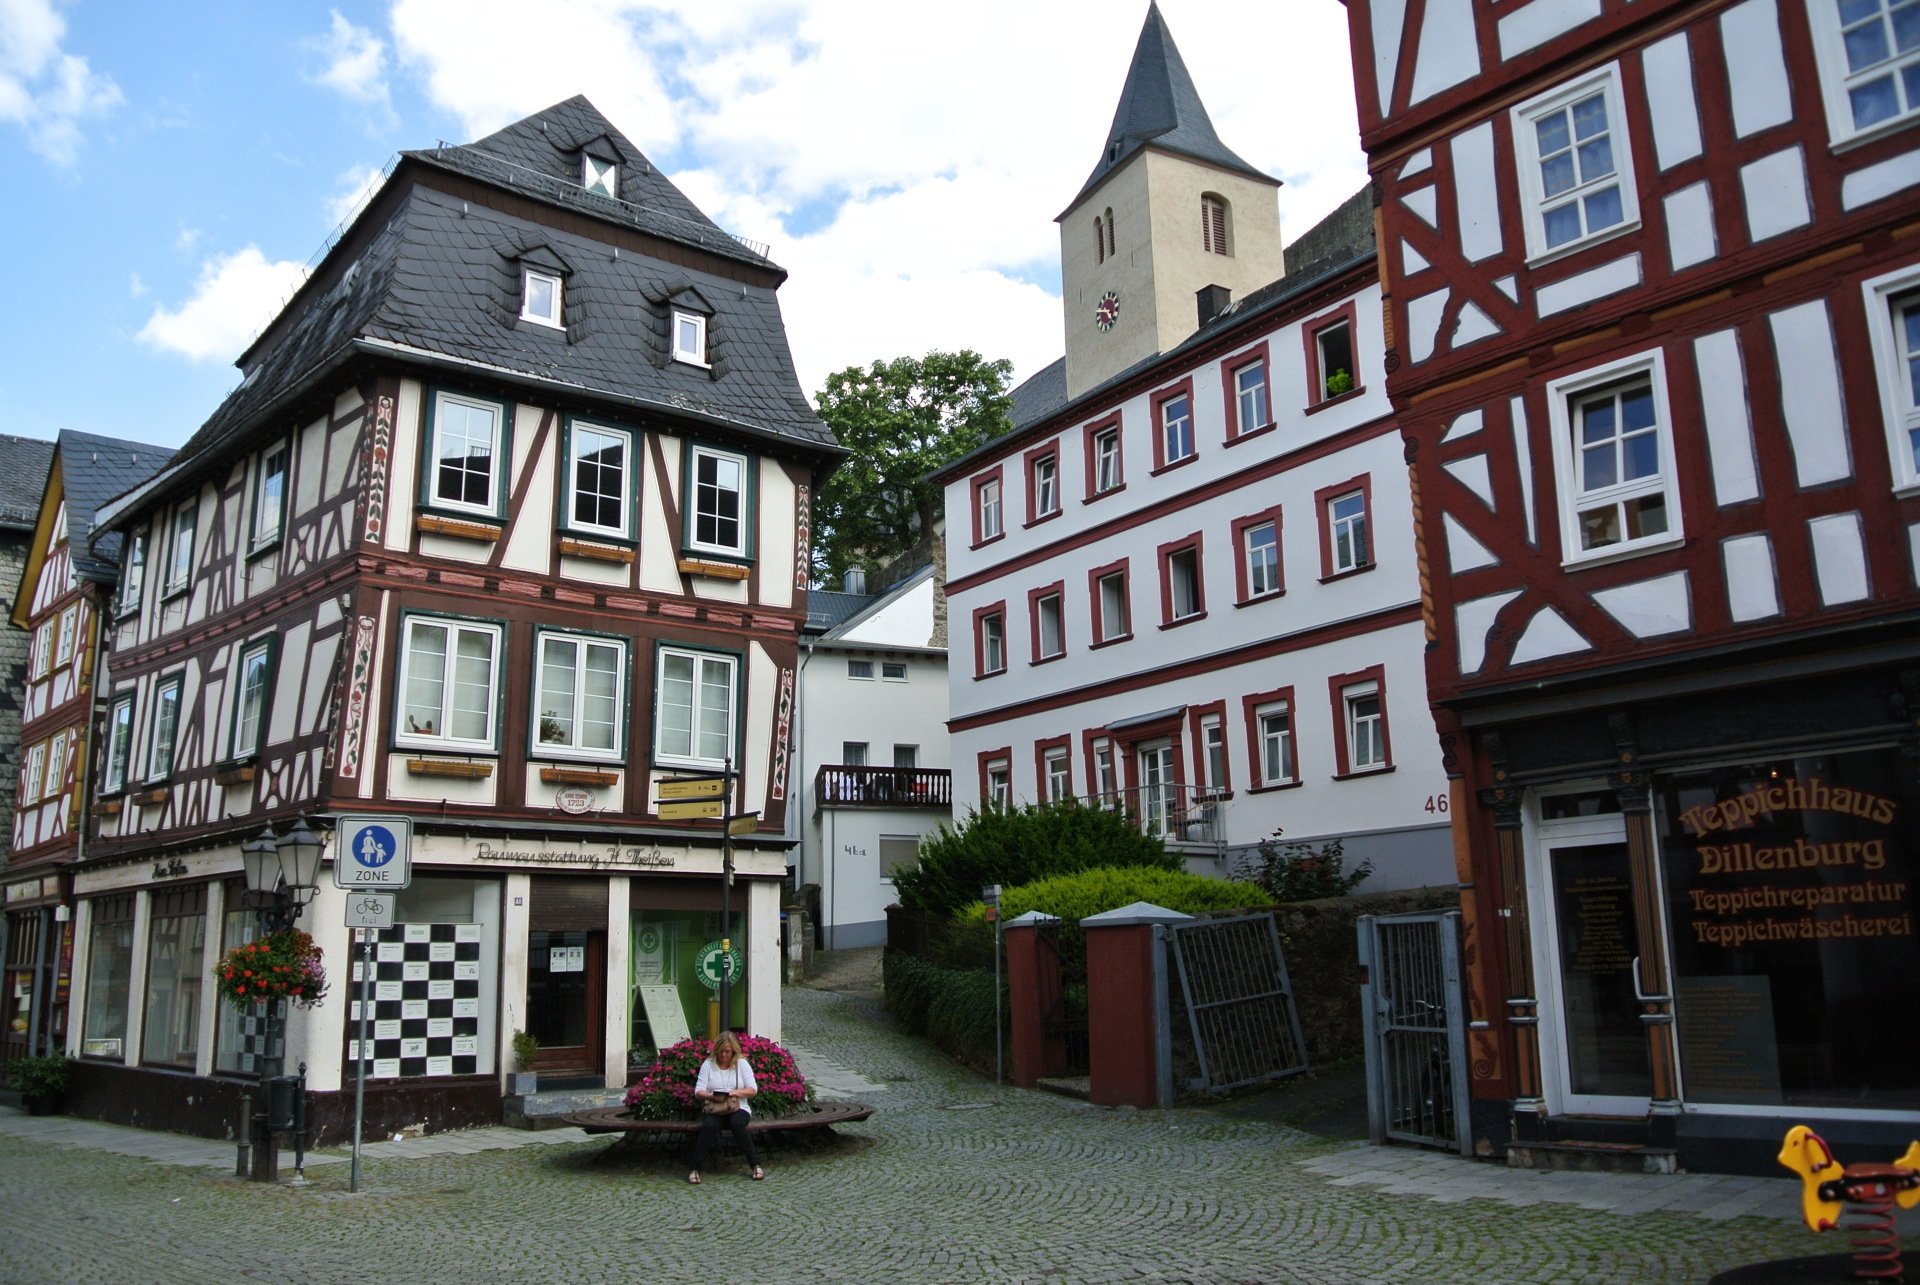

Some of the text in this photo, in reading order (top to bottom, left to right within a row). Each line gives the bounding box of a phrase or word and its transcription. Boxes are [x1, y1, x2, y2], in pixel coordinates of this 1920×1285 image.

[1425, 794, 1449, 814] 46
[1679, 779, 1897, 839] Teppichhaus
[474, 843, 600, 869] Raumausstattung
[626, 848, 675, 868] Theißen
[1696, 839, 1888, 874] Dillenburg
[355, 871, 389, 881] ZONE
[1689, 881, 1906, 914] Teppichreparatur
[361, 916, 376, 924] frei
[1692, 914, 1911, 947] Teppichwäscherei
